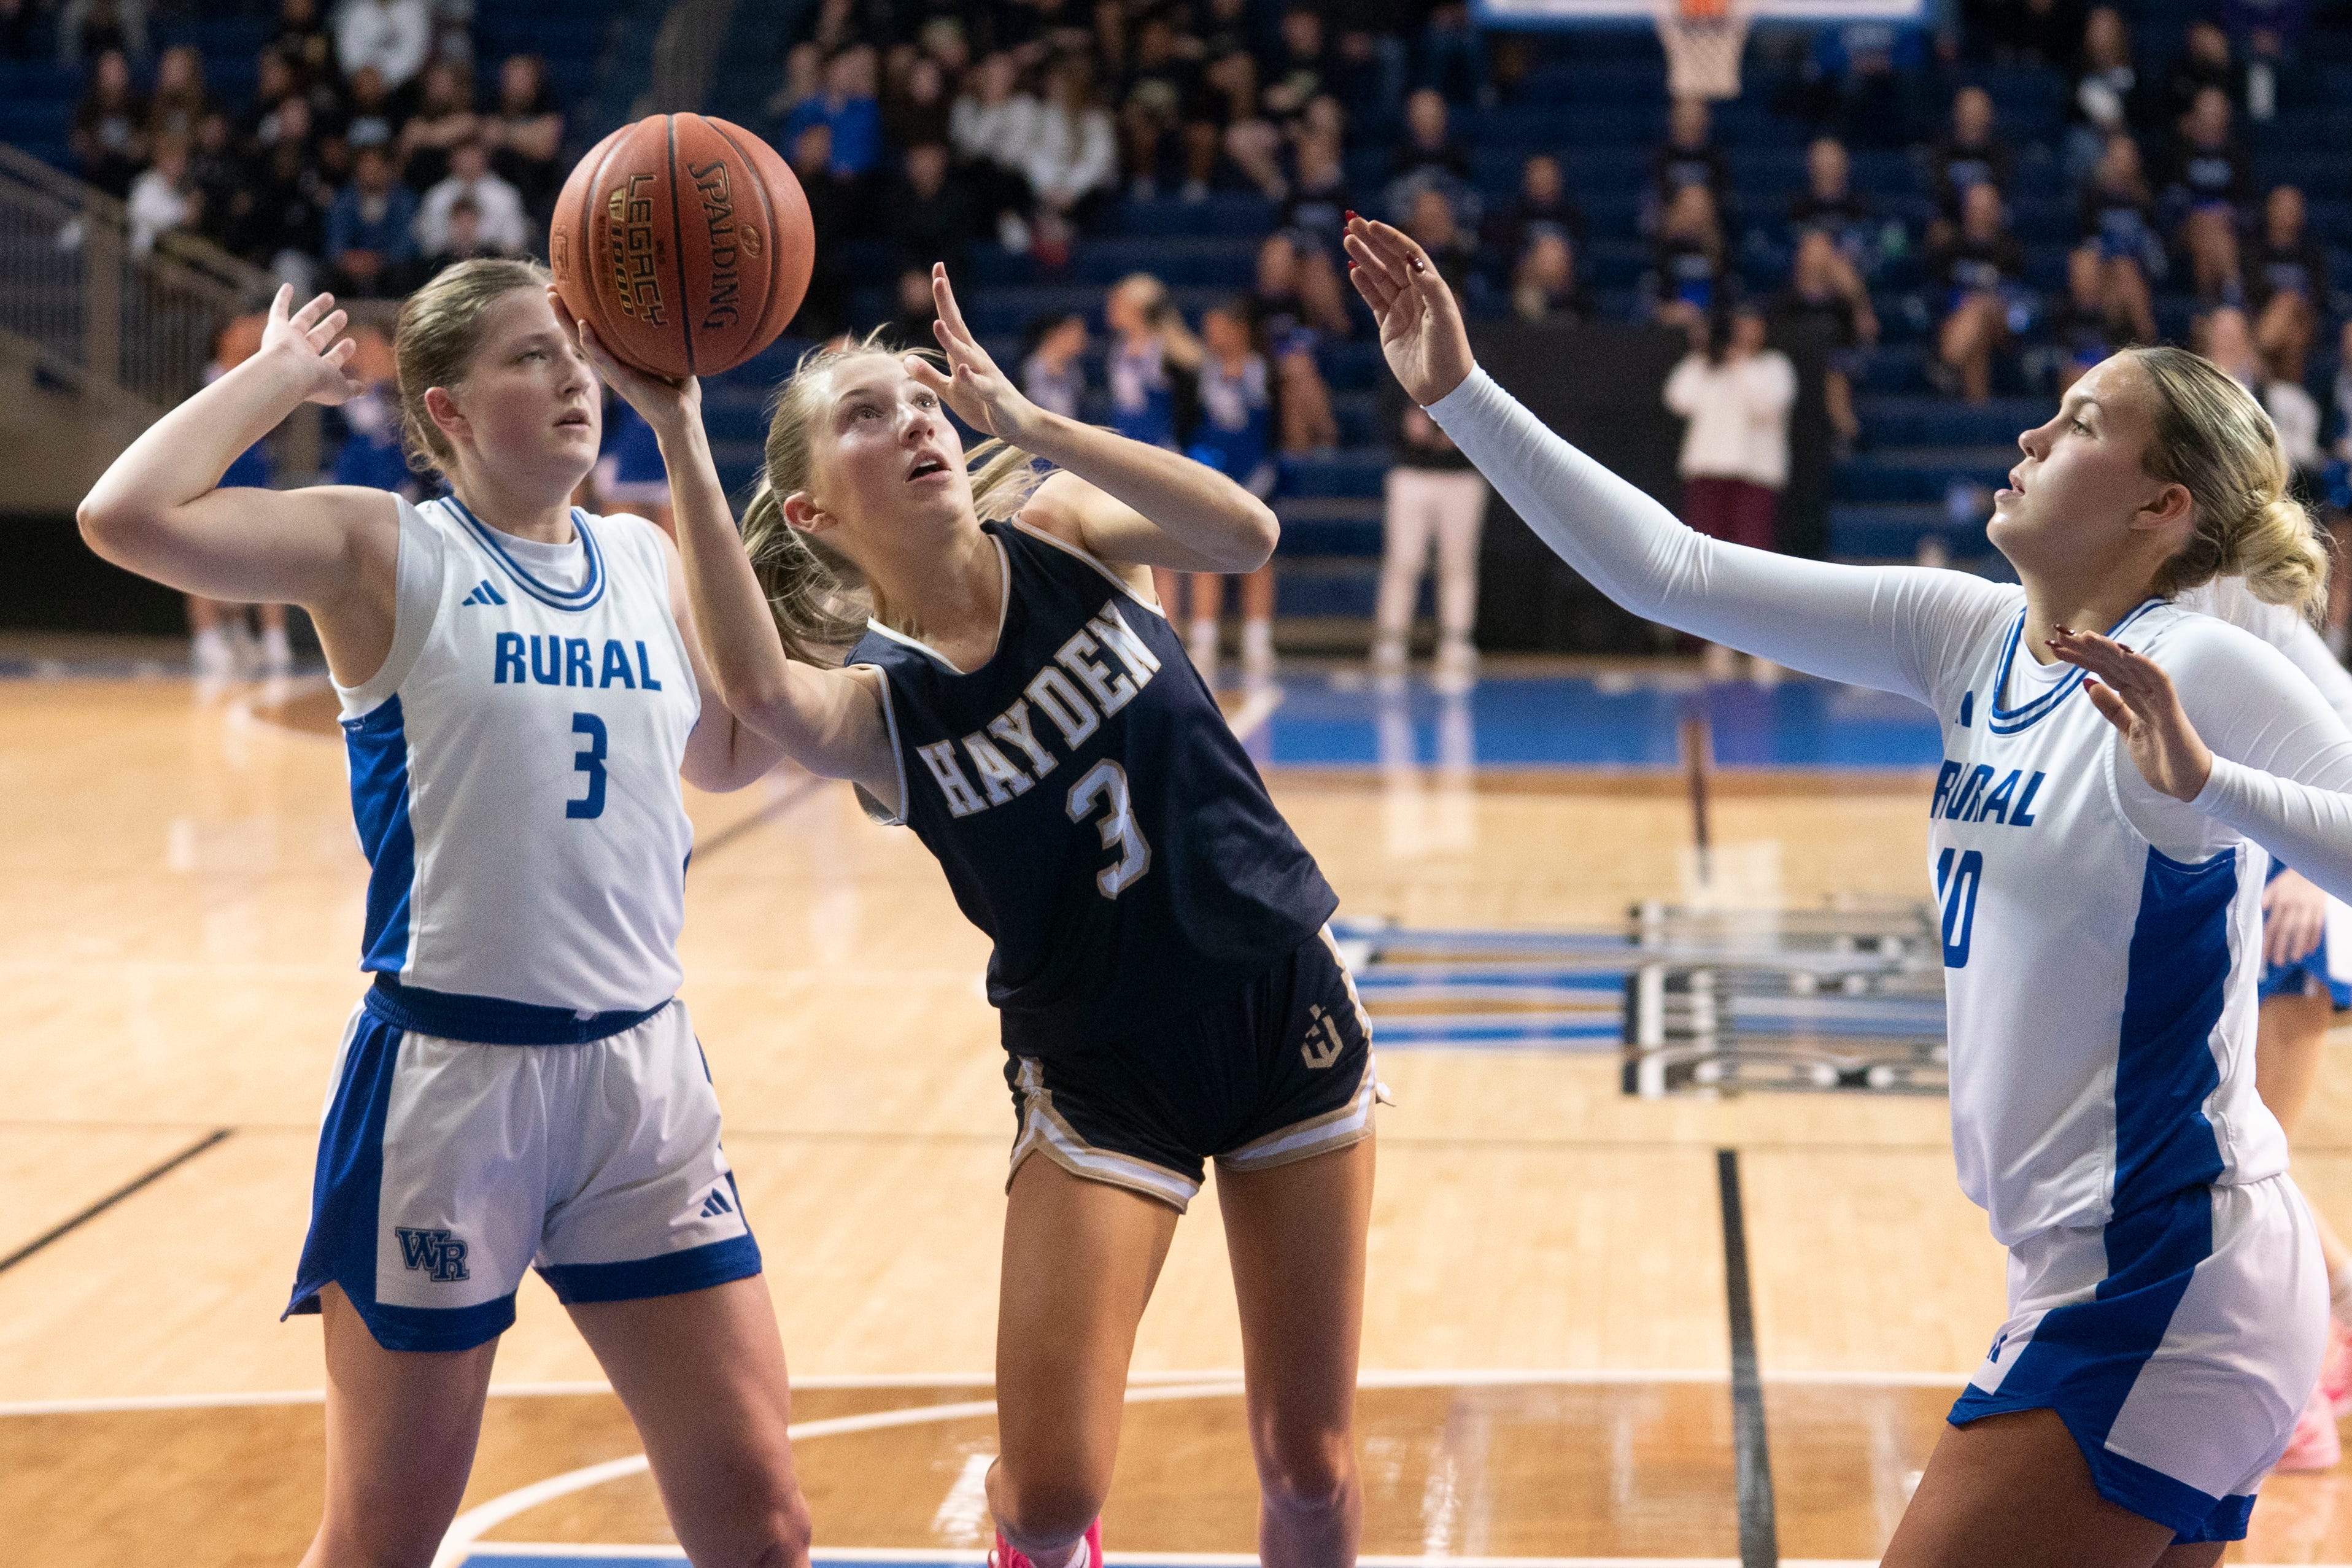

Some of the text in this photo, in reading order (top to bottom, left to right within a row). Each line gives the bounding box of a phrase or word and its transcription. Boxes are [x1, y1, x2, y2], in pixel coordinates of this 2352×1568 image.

[627, 173, 670, 328] LEGACY
[688, 161, 739, 330] SPALDING
[494, 631, 662, 691] RURAL
[916, 599, 1162, 818] HAYDEN
[566, 712, 607, 819] 3
[1930, 759, 2046, 827] RURAL
[1066, 758, 1152, 900] 3
[395, 1226, 470, 1283] WR
